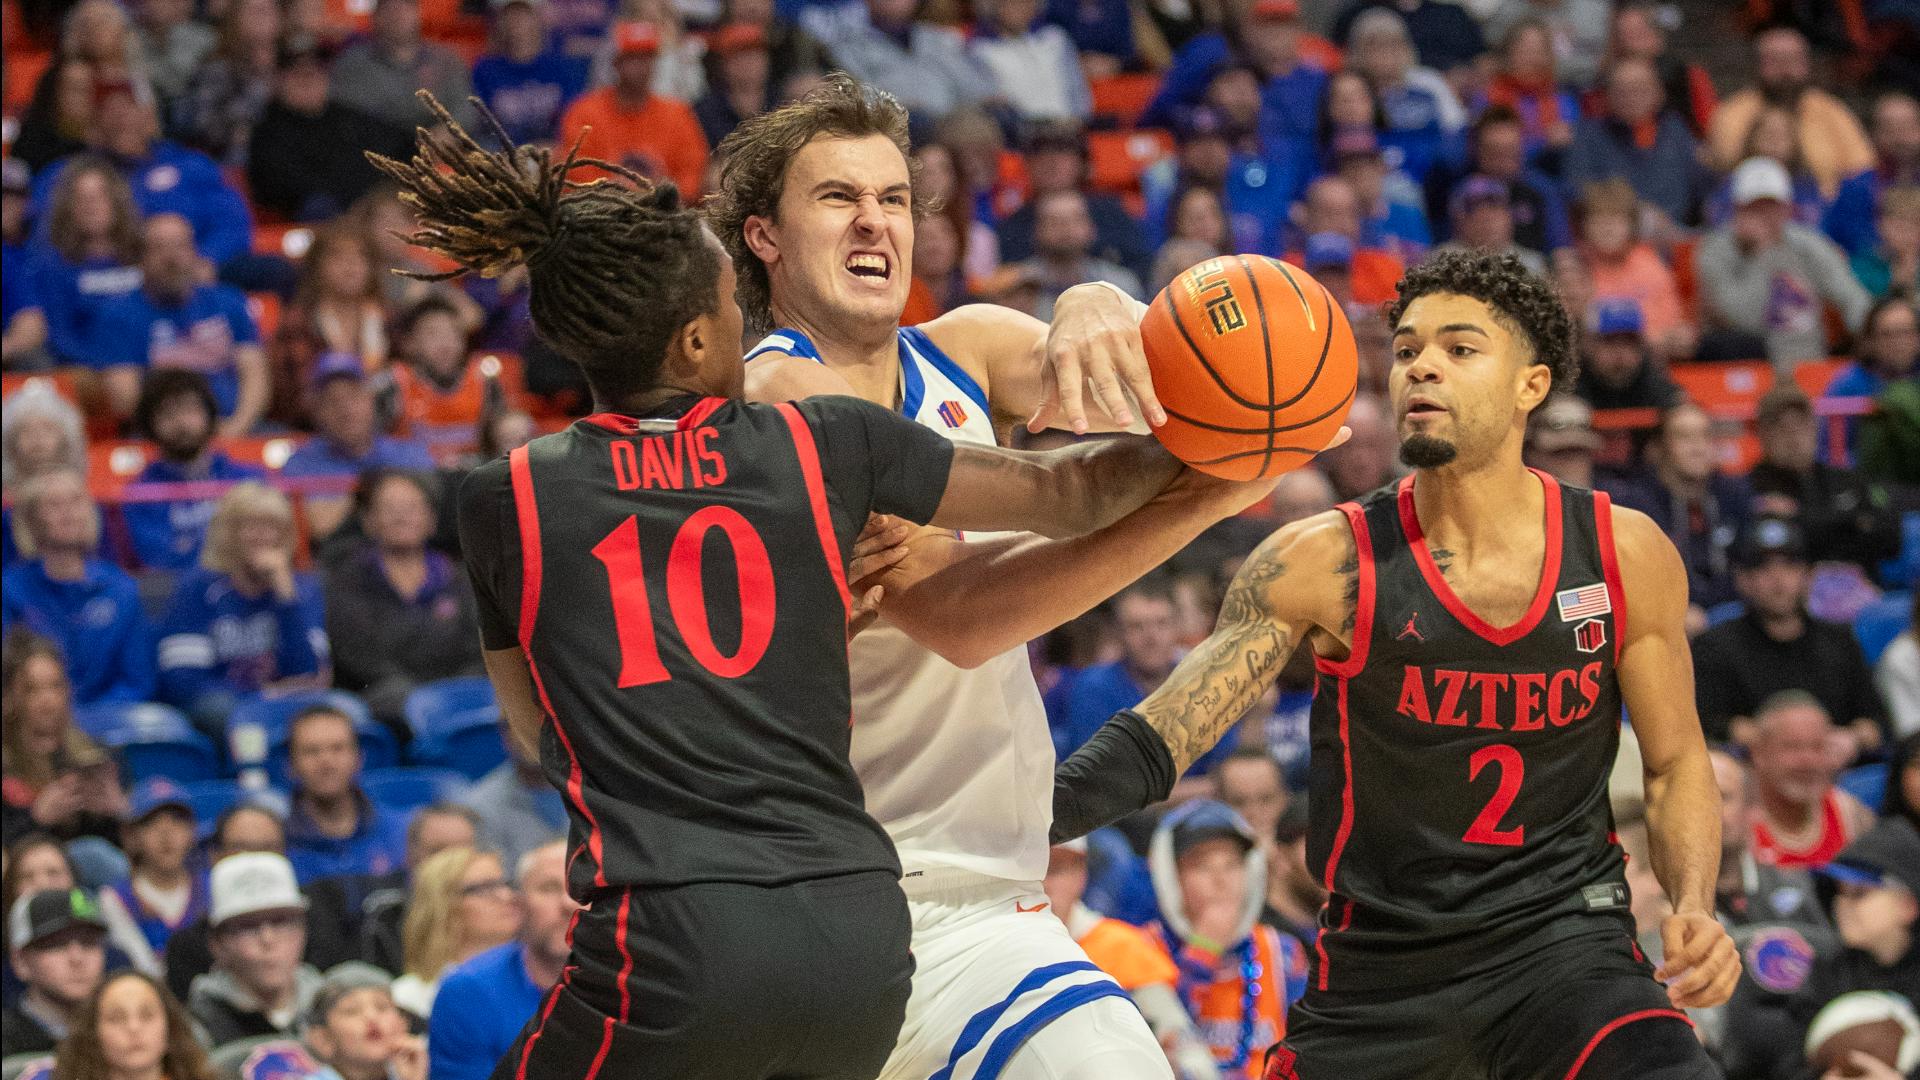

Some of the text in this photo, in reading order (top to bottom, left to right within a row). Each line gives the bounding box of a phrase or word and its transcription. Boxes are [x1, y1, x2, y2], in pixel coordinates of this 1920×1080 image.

[1190, 259, 1247, 335] ELITE
[610, 426, 727, 491] DAVIS
[591, 505, 776, 689] 10
[1246, 632, 1280, 680] God
[1396, 661, 1603, 731] AZTECS
[1462, 744, 1525, 846] 2
